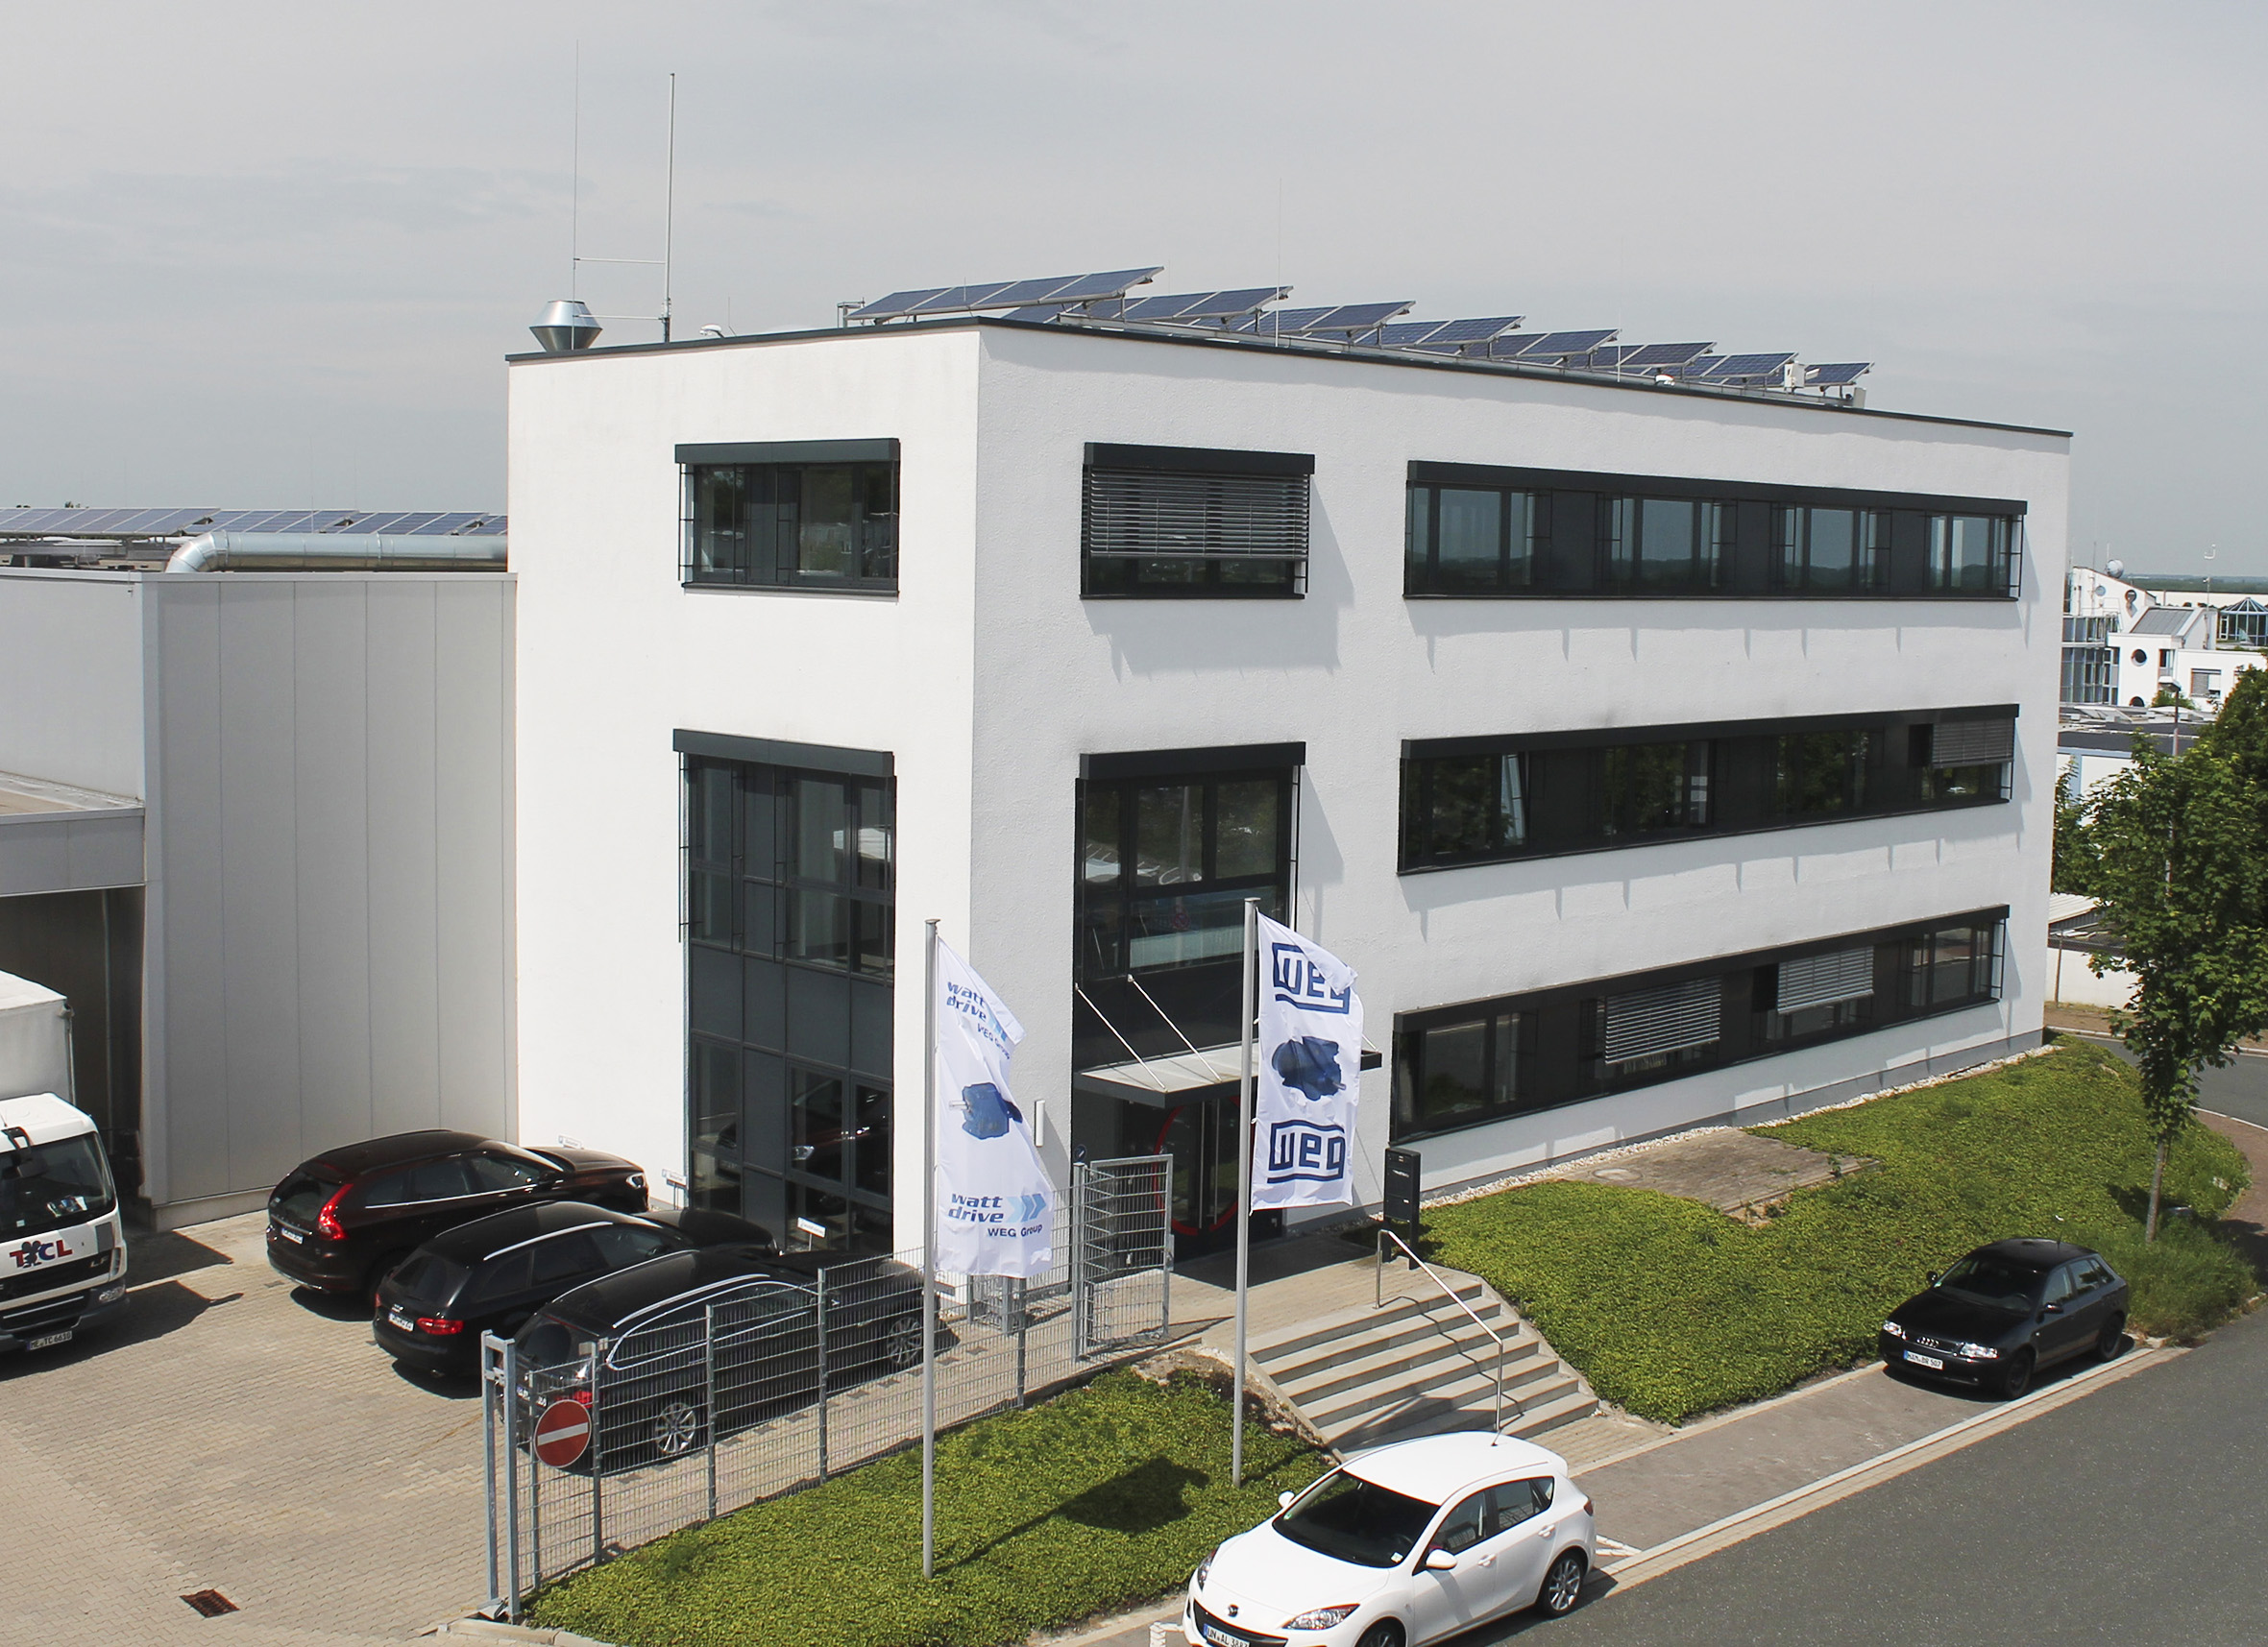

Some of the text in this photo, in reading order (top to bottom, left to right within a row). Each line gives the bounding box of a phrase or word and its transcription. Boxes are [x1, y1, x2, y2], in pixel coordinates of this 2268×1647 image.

[947, 981, 985, 1008] watt
[946, 995, 987, 1023] drive
[951, 1193, 1003, 1208] watt
[948, 1206, 1005, 1223] drive
[988, 1223, 1043, 1238] WEG Group
